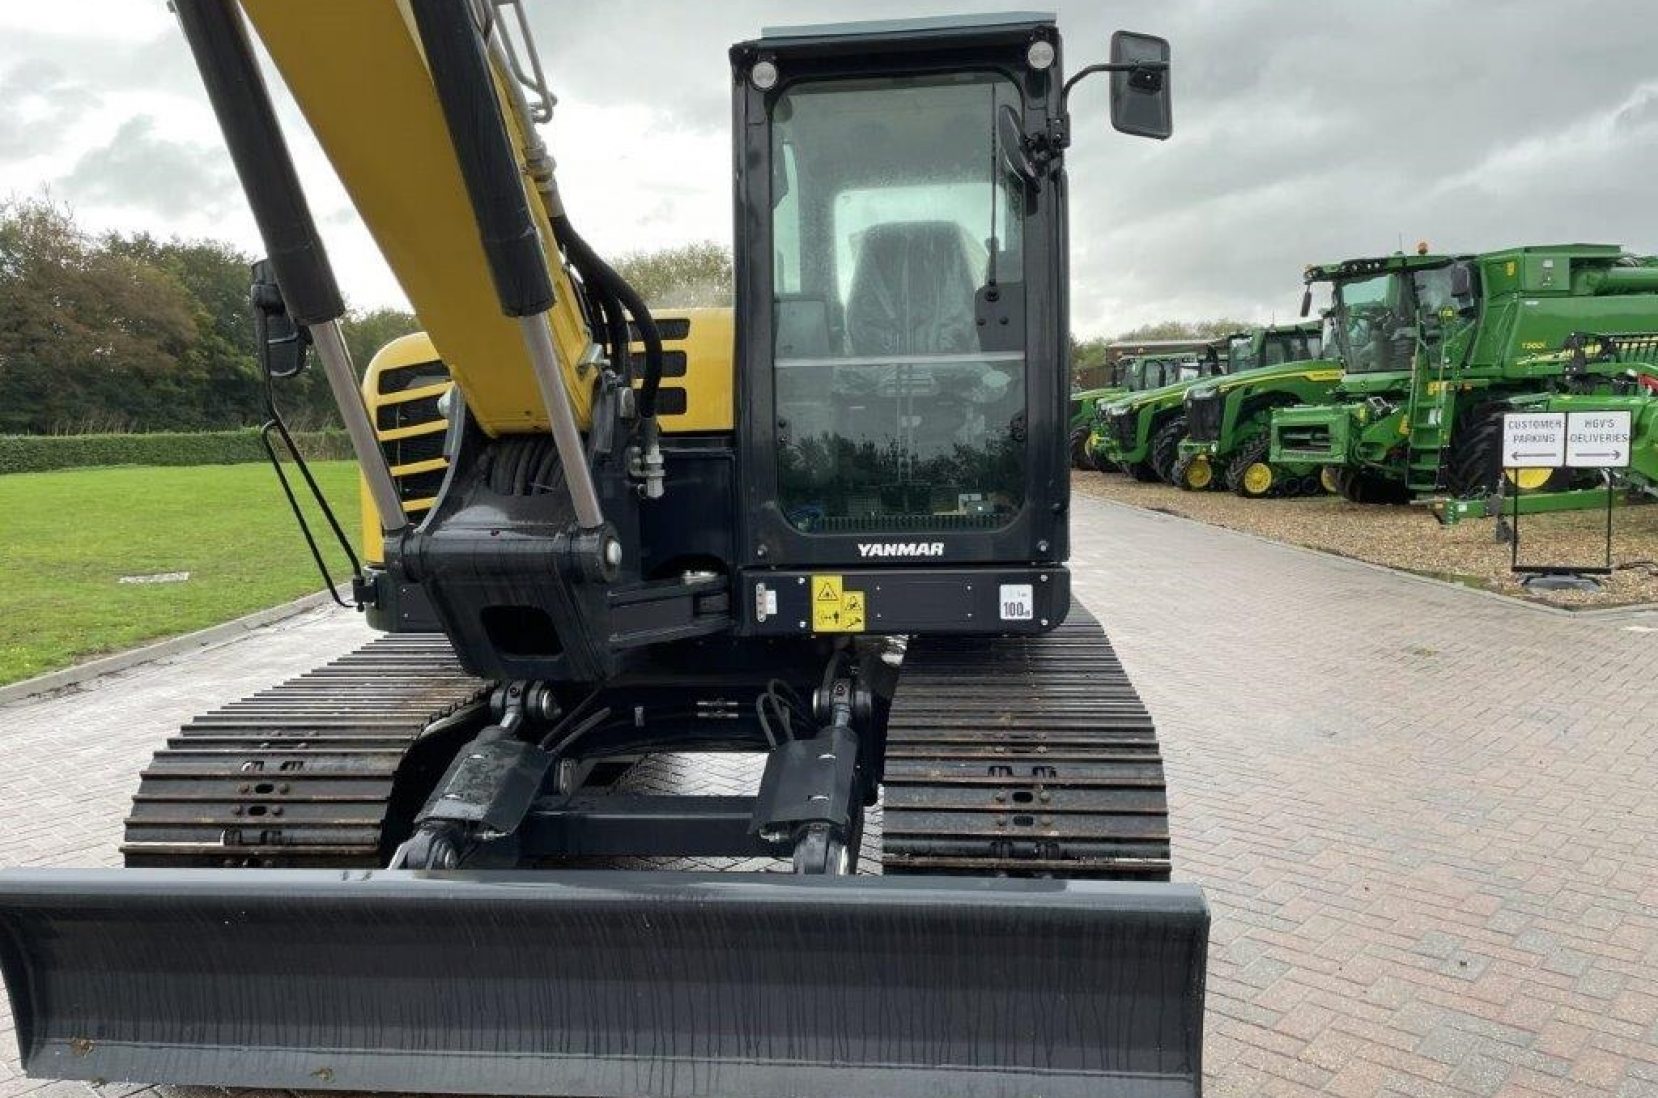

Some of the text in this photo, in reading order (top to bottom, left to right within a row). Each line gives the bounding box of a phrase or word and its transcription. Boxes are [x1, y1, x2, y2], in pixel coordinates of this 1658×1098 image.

[1509, 420, 1562, 429] CUSTOMER
[1513, 434, 1555, 443] PARKING
[1570, 433, 1628, 443] DELIVERIES
[858, 542, 944, 556] YANMAR
